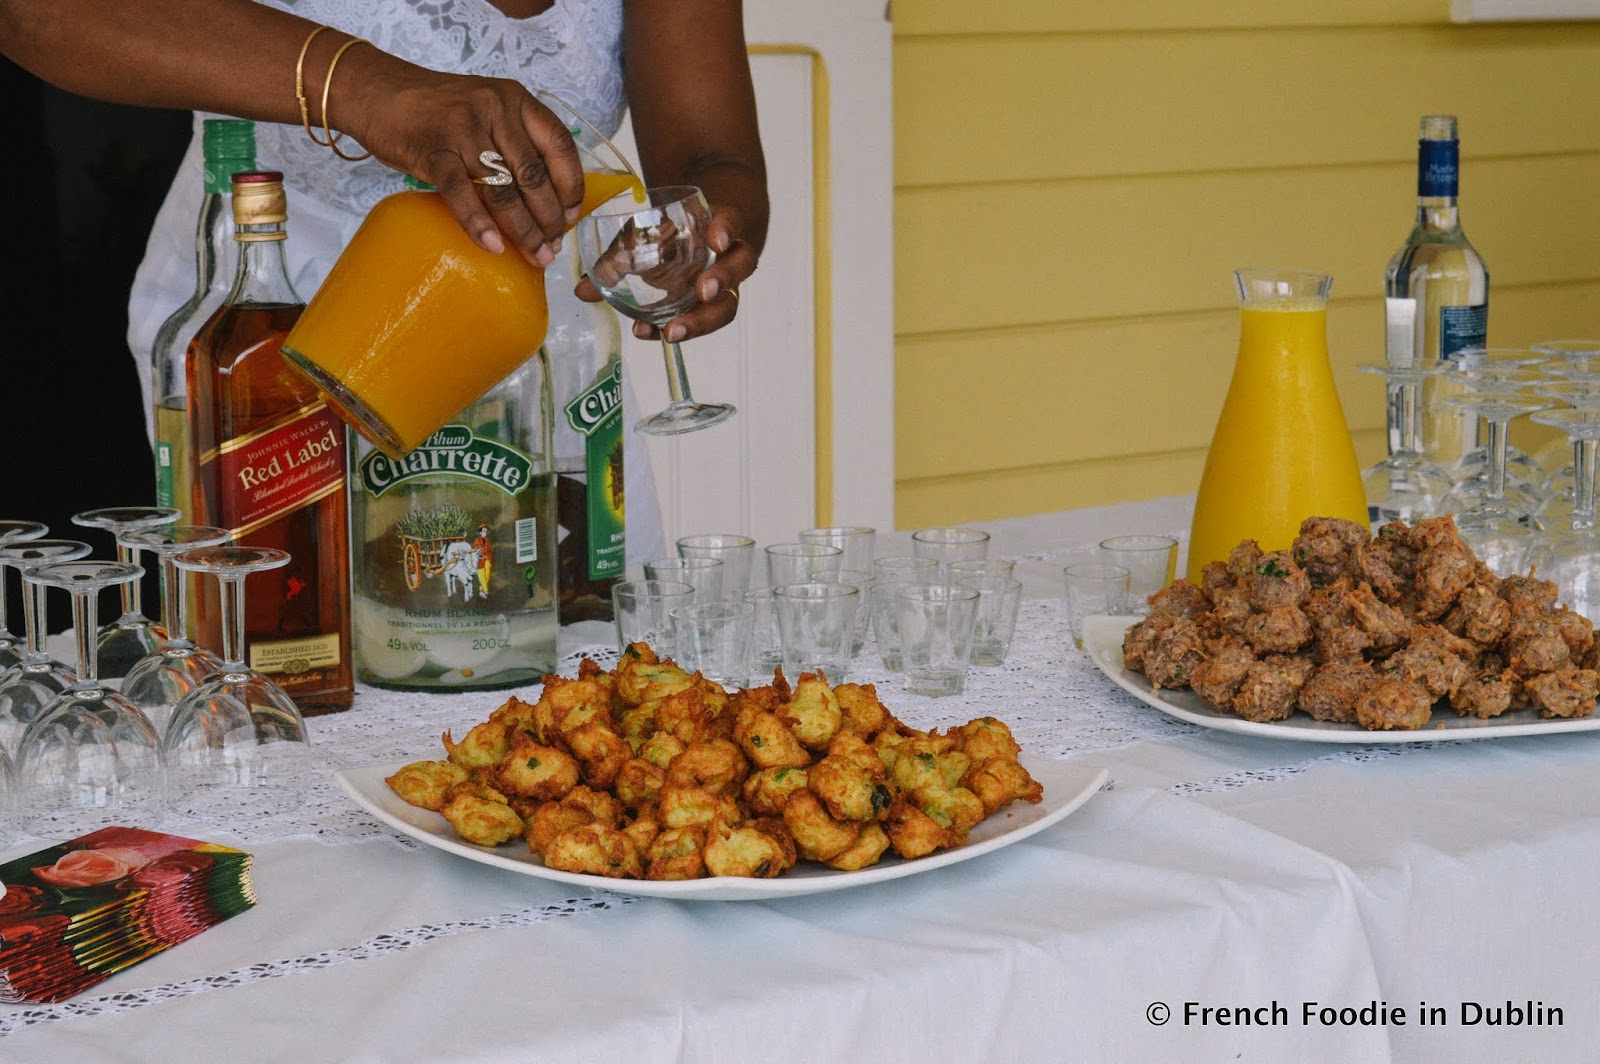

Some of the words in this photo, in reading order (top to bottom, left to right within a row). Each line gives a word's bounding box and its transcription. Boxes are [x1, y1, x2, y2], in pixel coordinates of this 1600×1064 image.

[426, 431, 466, 448] Rhum
[238, 453, 283, 490] Red
[284, 428, 338, 469] Label
[247, 439, 289, 464] JOHNNIE
[369, 449, 521, 487] Charrette
[405, 609, 440, 617] RHUM
[447, 608, 488, 617] BLANC
[387, 620, 443, 628] TRADITIONNEL
[262, 645, 311, 657] ESTABLISHED
